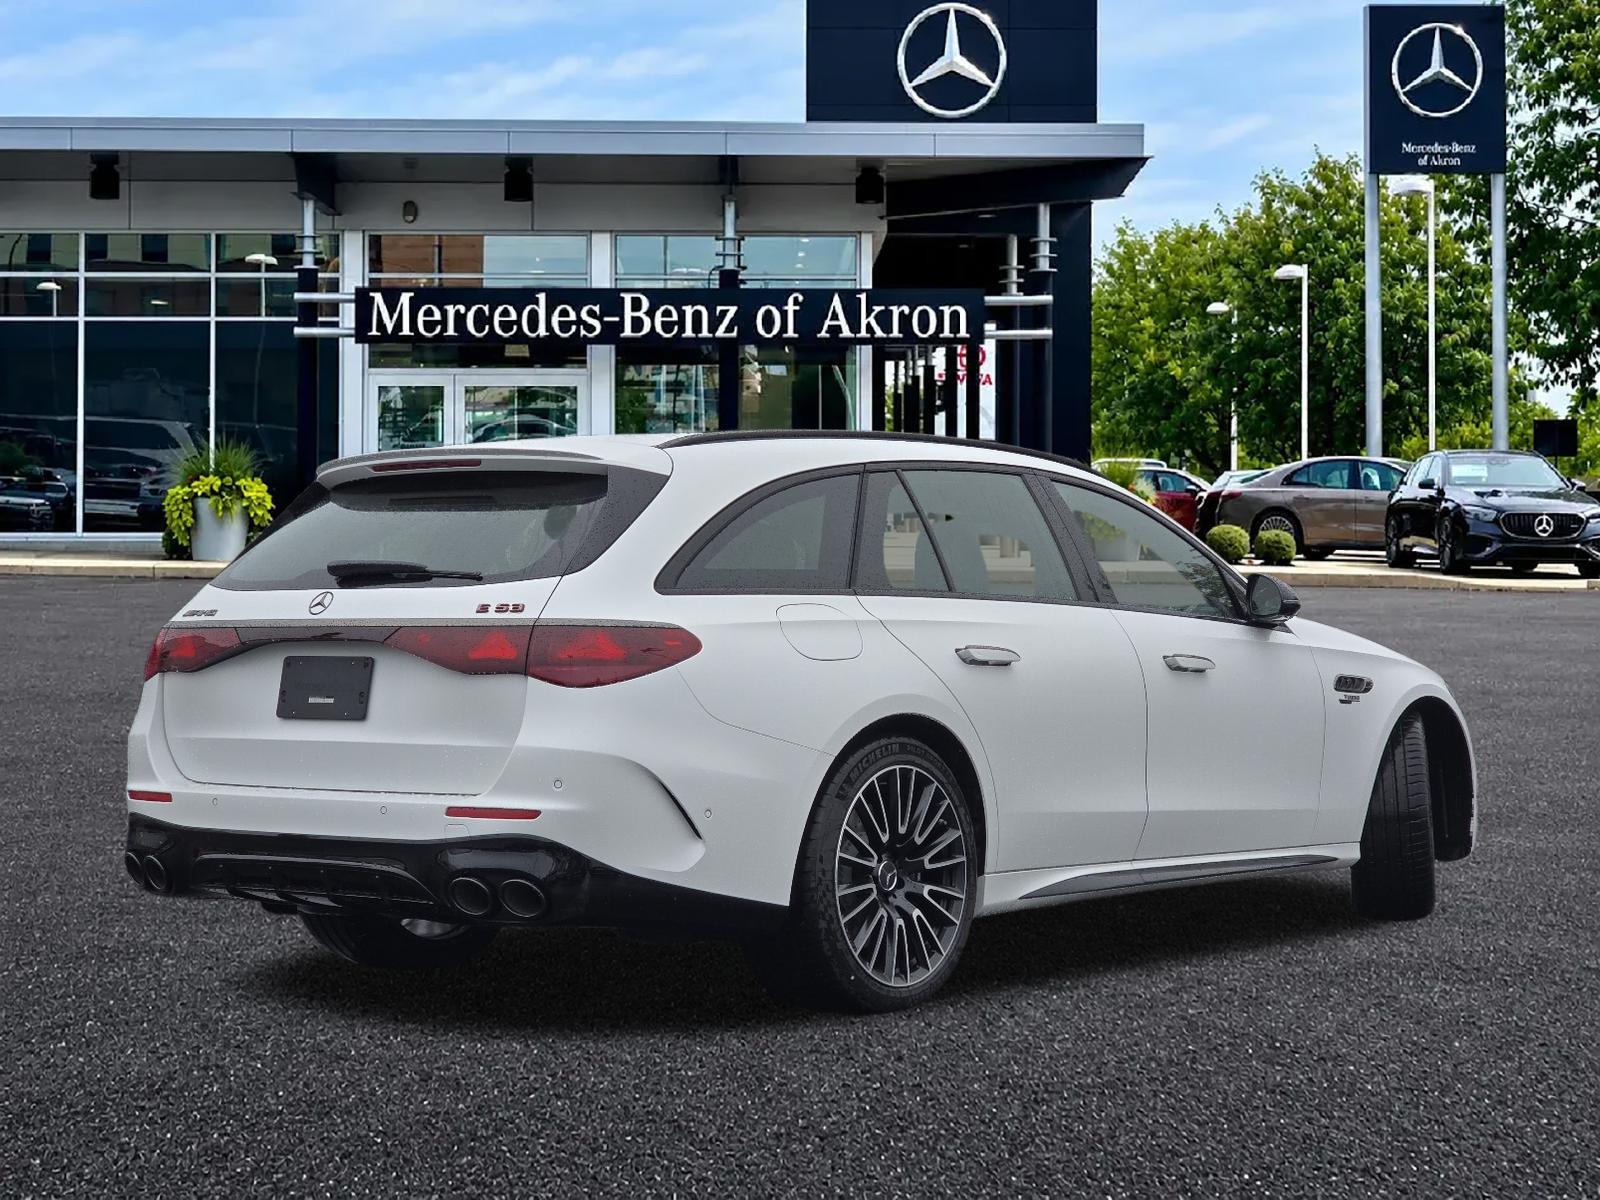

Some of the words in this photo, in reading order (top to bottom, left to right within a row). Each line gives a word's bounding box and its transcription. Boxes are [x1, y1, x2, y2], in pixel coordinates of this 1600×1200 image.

[1401, 142, 1476, 154] Mercedes-Benz
[1418, 155, 1429, 166] of
[1430, 155, 1461, 166] Akron
[367, 291, 738, 340] Mercedes-Benz
[755, 292, 804, 340] of
[815, 291, 970, 340] Akron
[475, 603, 492, 614] E
[494, 603, 526, 614] 53
[849, 743, 899, 783] MICHELIN
